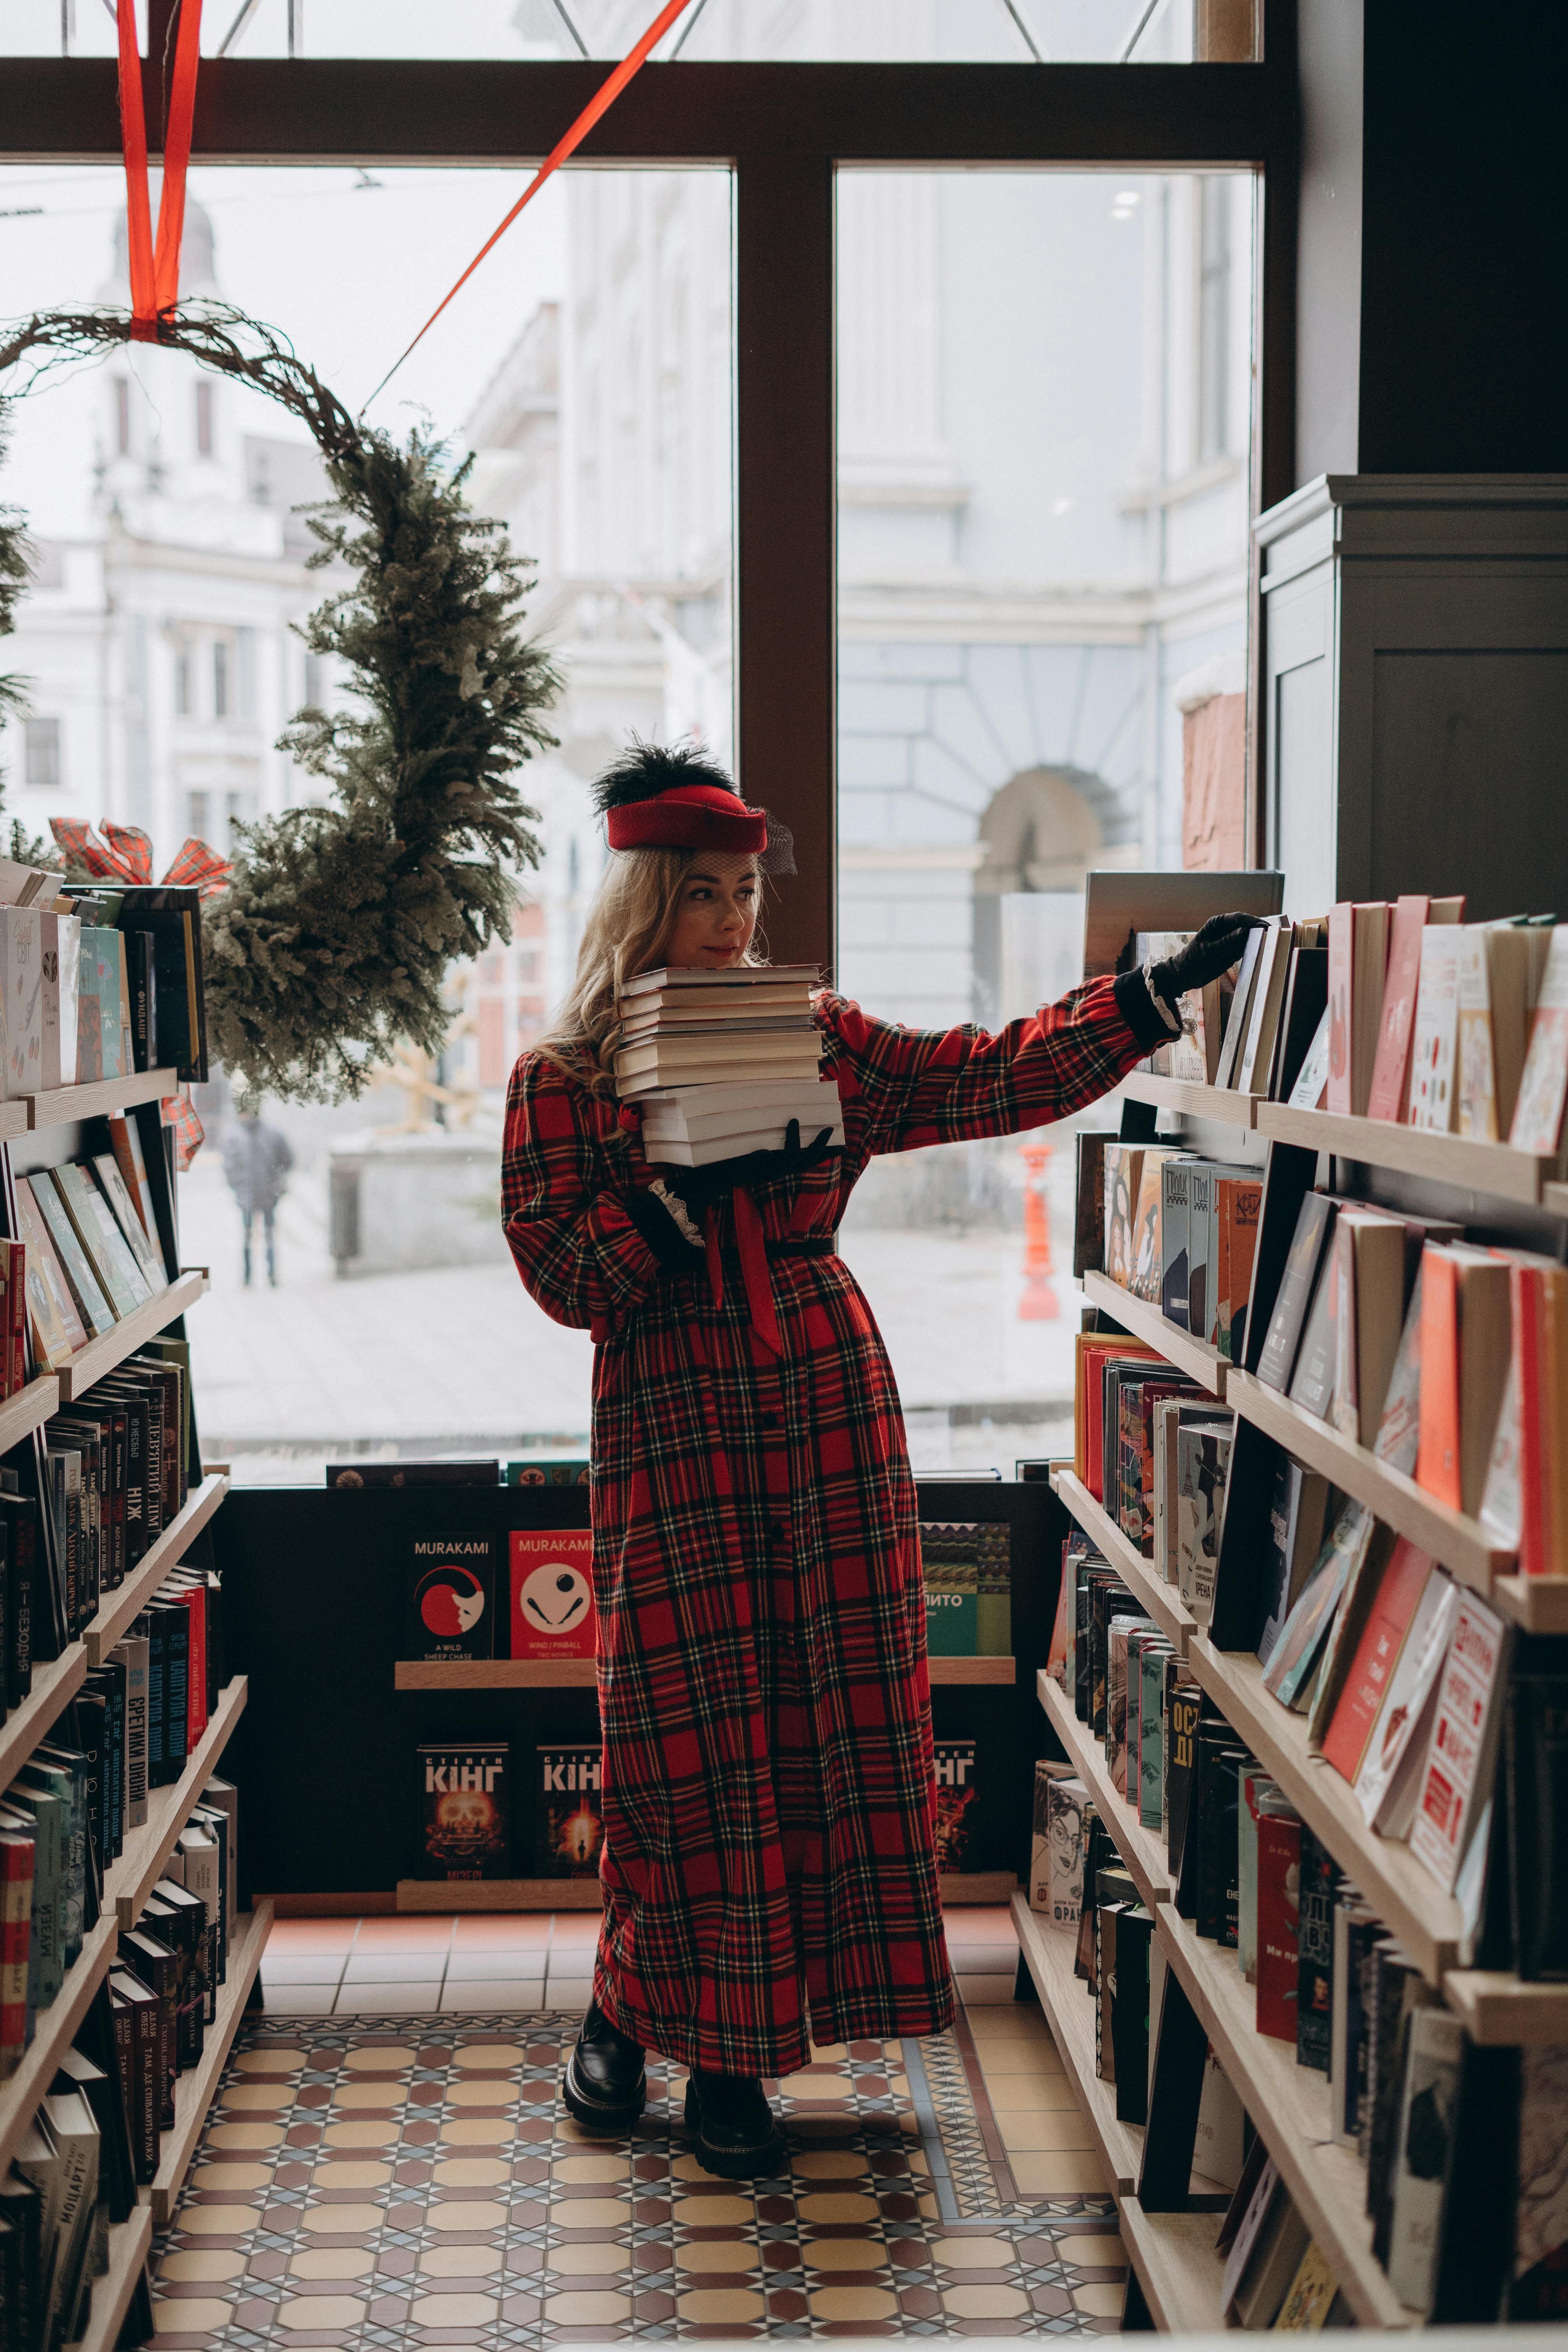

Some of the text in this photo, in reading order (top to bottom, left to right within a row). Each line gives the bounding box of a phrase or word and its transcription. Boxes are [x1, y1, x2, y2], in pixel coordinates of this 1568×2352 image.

[138, 991, 146, 1039] ФУНДАЦІЯ
[14, 1353, 23, 1381] Жадан
[131, 1418, 139, 1426] Ю
[80, 1497, 86, 1509] ДЕ
[89, 1493, 96, 1504] ДЕ
[127, 1486, 142, 1521] НІЖ
[148, 1498, 160, 1526] ДІМ
[68, 1529, 78, 1573] ЛИХИЙ
[414, 1542, 488, 1555] MURAKAMI
[20, 1581, 30, 1590] Я
[67, 1575, 76, 1619] КОРОЛЬ
[1196, 1581, 1211, 1599] ІРЕНА
[16, 1608, 30, 1672] БЕЗОДНЯ
[149, 1664, 163, 1723] КАПІТУЛА
[170, 1659, 186, 1718] КАПІТУЛА
[128, 1696, 146, 1759] ЄРЕТИКИ
[425, 1765, 504, 1793] КІНГ
[38, 1904, 53, 1957] МУЗЕЙ
[1266, 1944, 1282, 1957] Ми
[144, 2047, 152, 2070] ТАМ,
[144, 2073, 152, 2085] ДЕ
[145, 2087, 153, 2134] СПІВАЮТЬ
[60, 2166, 86, 2224] МОЦАРТ
